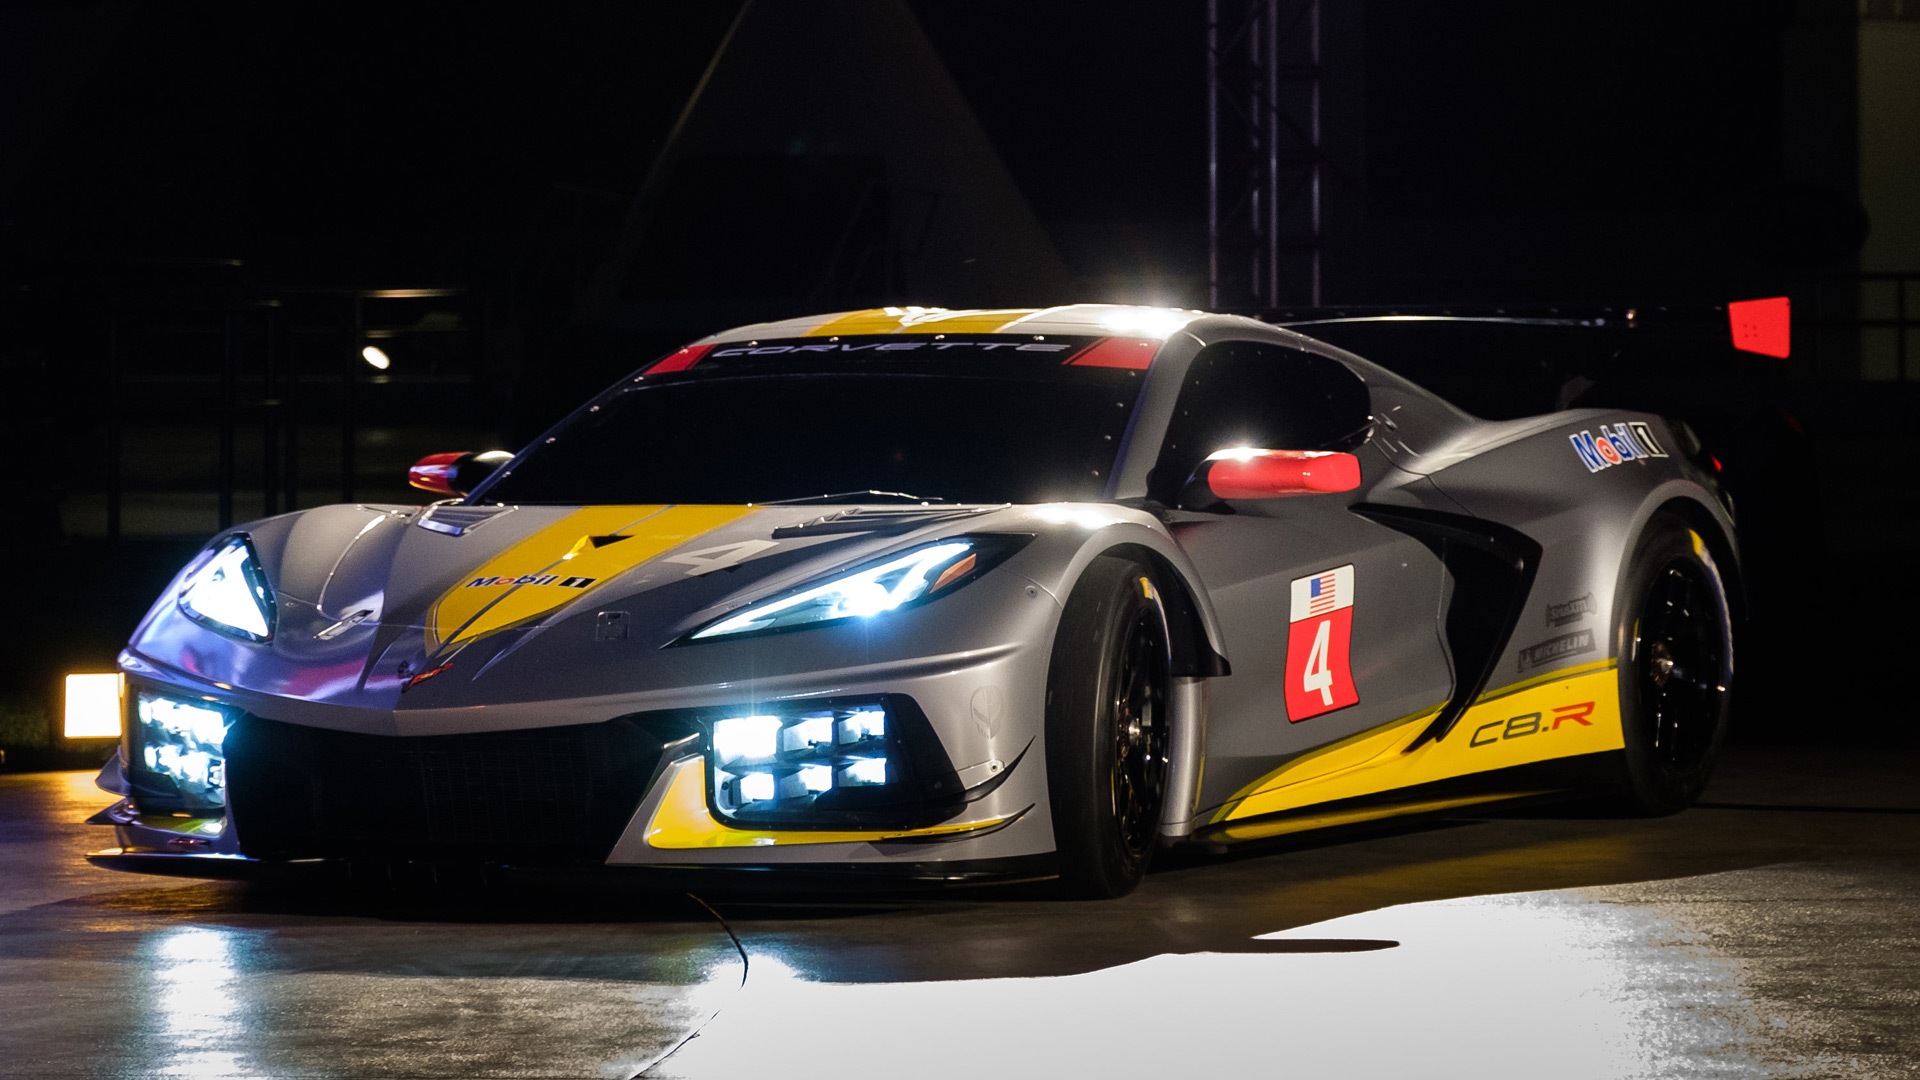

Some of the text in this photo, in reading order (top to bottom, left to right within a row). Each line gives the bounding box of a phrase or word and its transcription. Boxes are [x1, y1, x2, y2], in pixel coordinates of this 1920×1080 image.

[711, 343, 1072, 358] CORVETTE
[1569, 423, 1665, 473] Mobil 1
[663, 539, 780, 577] 4
[465, 575, 558, 588] Mobil
[1303, 619, 1334, 707] 4
[1469, 701, 1596, 748] C8.R
